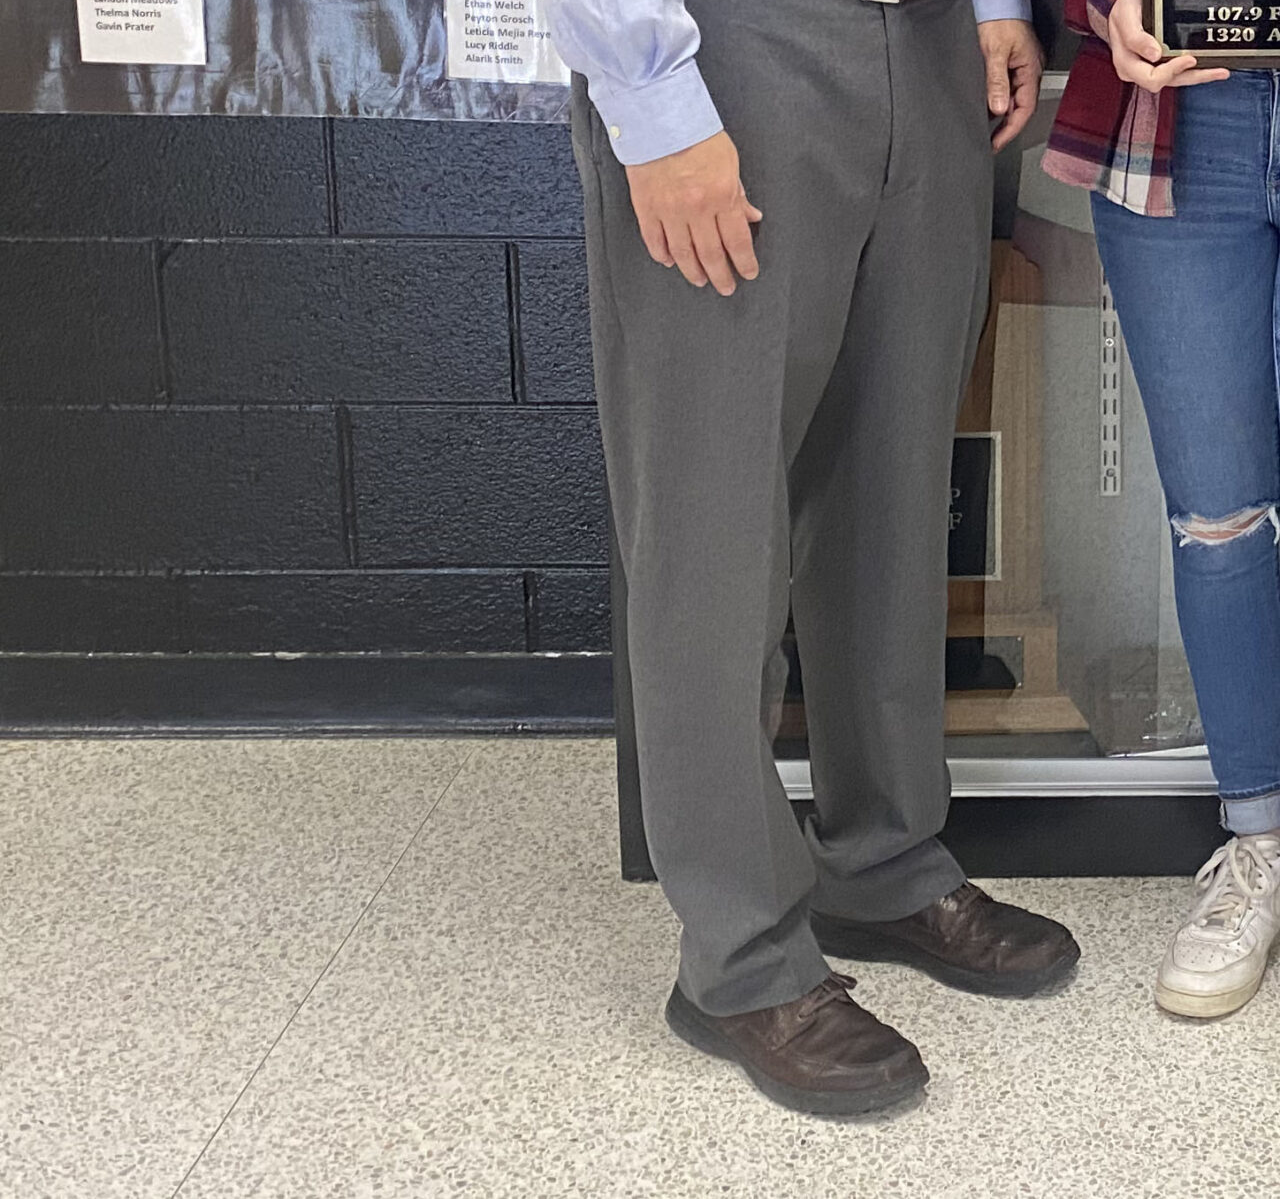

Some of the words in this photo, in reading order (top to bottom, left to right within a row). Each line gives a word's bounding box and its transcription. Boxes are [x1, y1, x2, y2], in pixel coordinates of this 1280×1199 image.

[464, 0, 491, 9] Ethan
[495, 1, 525, 10] Welch
[95, 8, 129, 17] Thelma
[132, 9, 161, 18] Norris
[1206, 6, 1263, 21] 107.9
[465, 13, 498, 24] Peyton
[500, 15, 534, 24] Grosch
[96, 22, 122, 30] Gavin
[125, 23, 155, 31] Prater
[465, 27, 494, 36] Leticia
[498, 29, 525, 39] Mejia
[1206, 28, 1255, 42] 1320
[465, 41, 486, 50] Lucy
[488, 42, 519, 50] Riddle
[495, 56, 523, 65] Smith
